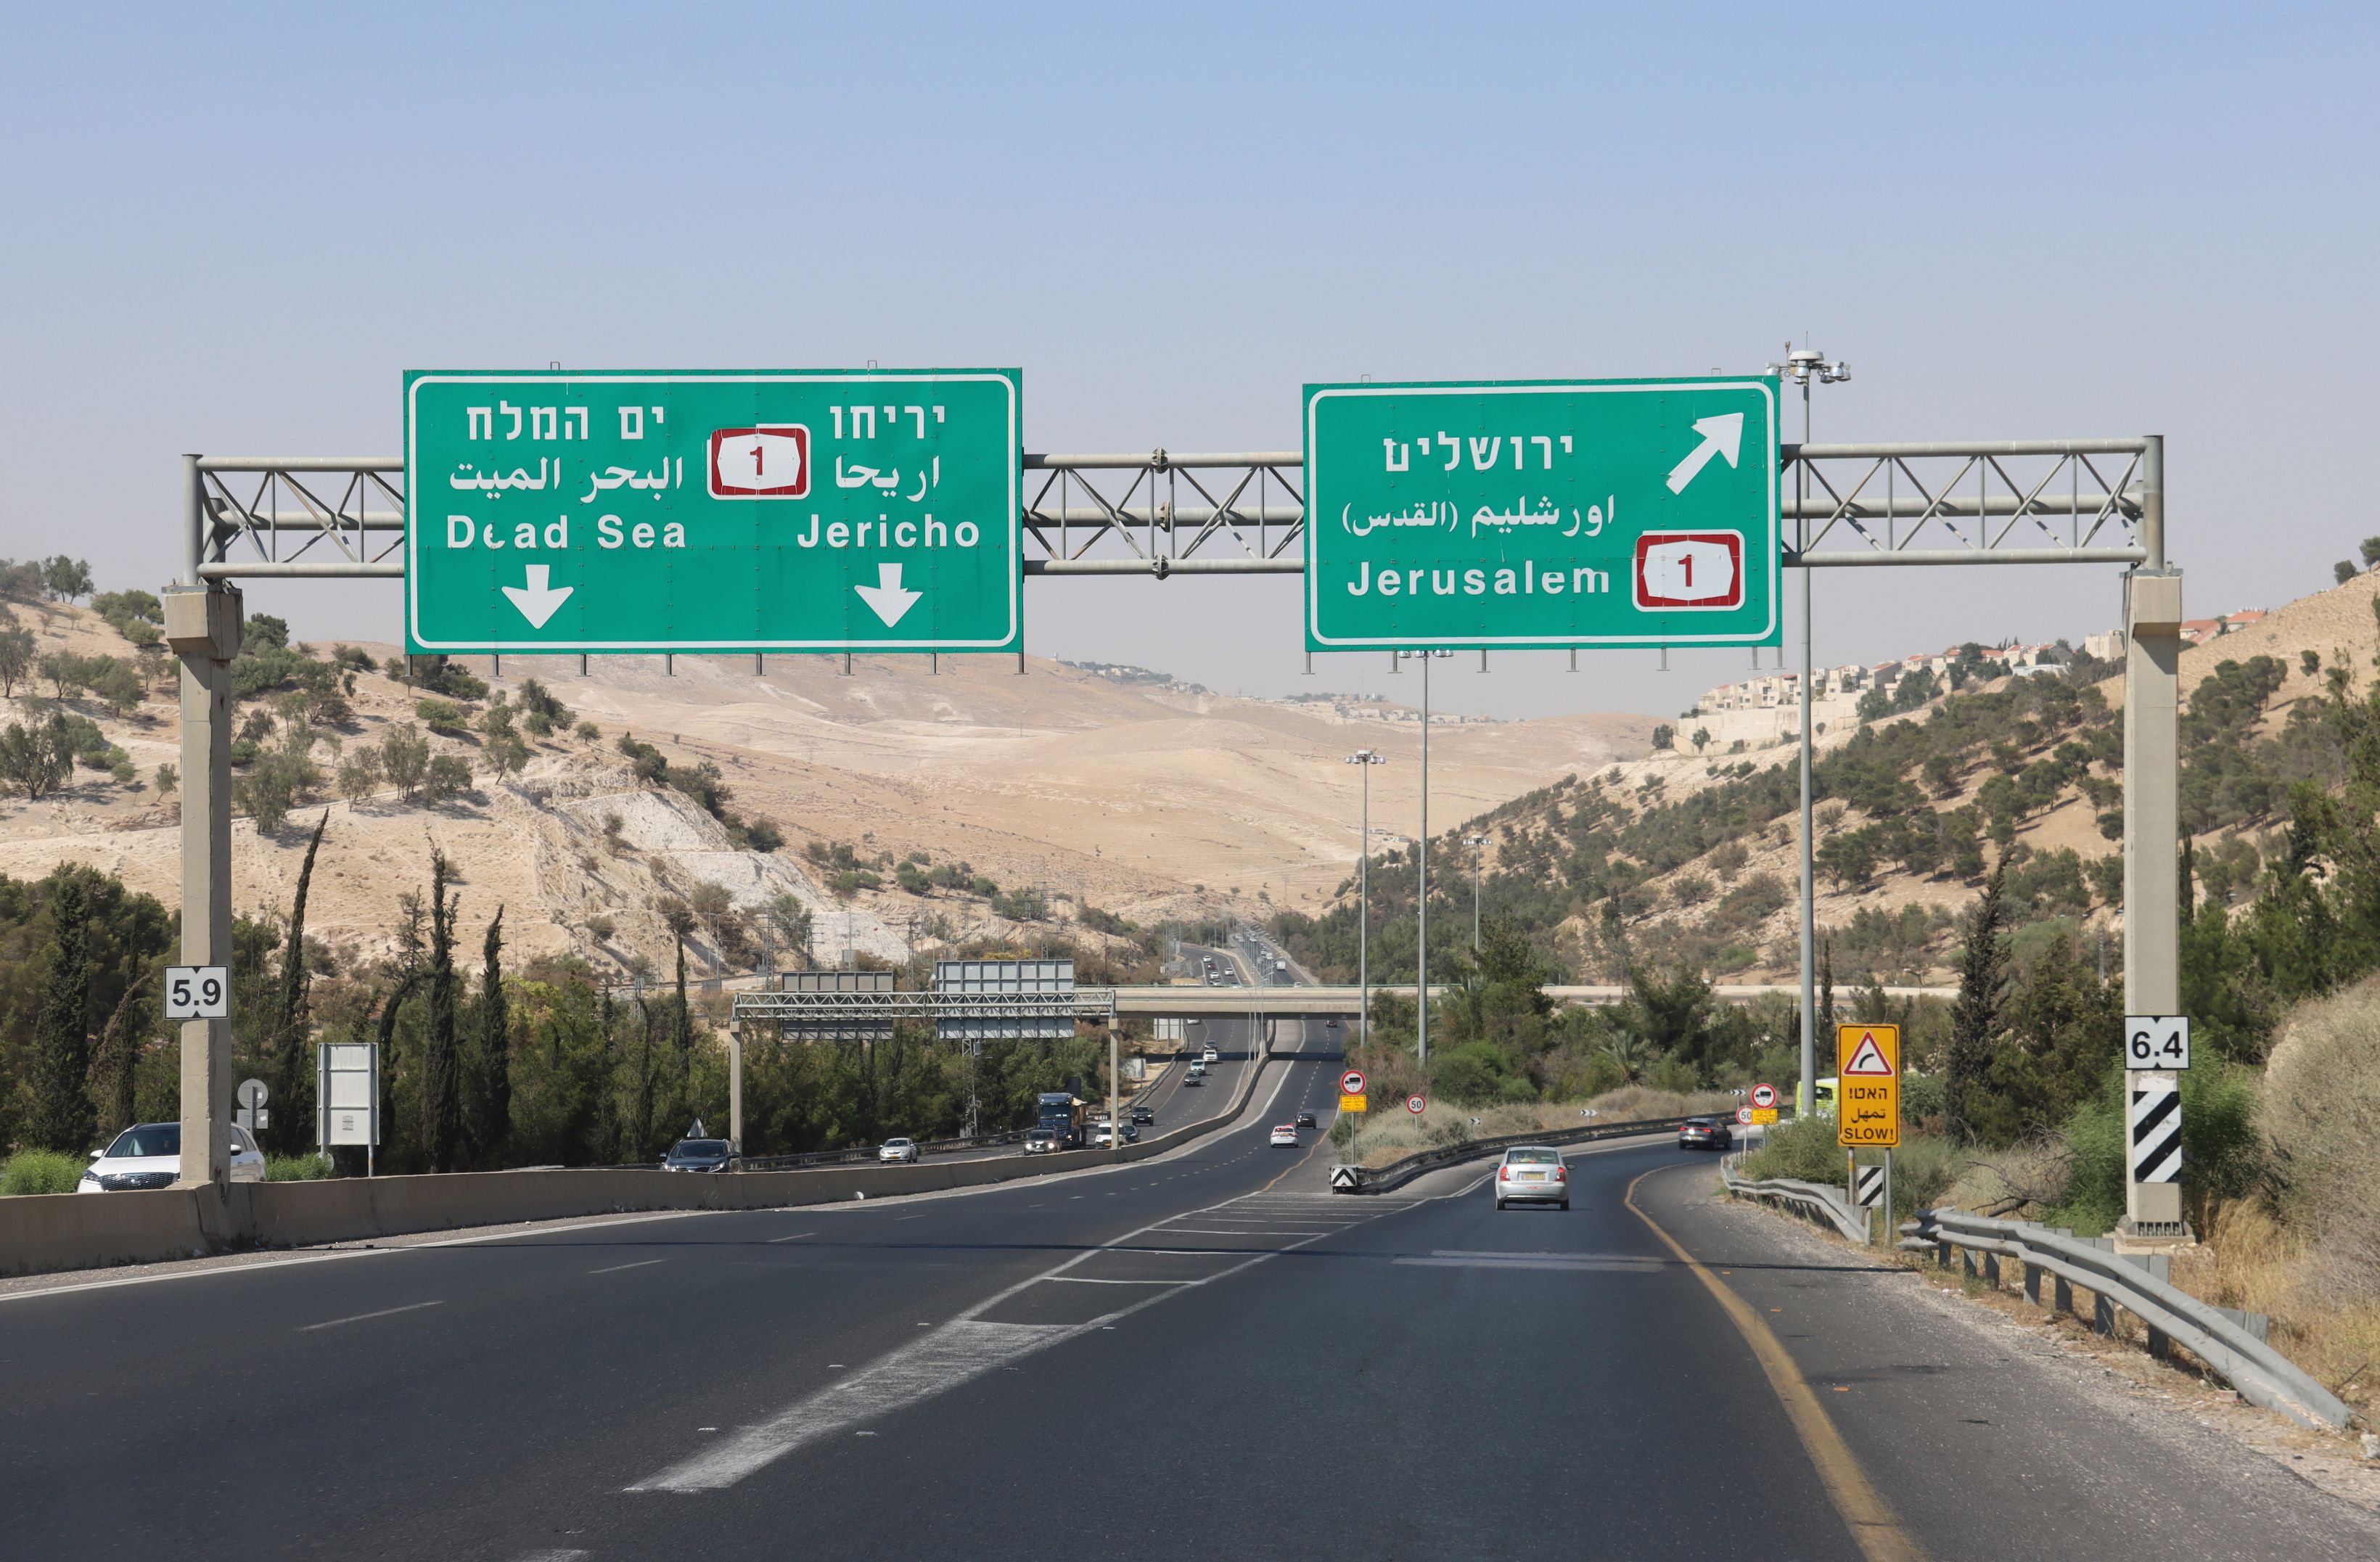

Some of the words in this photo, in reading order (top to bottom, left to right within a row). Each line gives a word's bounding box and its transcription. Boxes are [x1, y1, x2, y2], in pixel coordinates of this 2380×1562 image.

[467, 400, 588, 440] המלח
[617, 406, 664, 440] ים
[829, 406, 945, 439] יריחו
[749, 445, 763, 476] 1
[1383, 431, 1573, 472] ירושלים
[449, 456, 560, 499] الميت
[580, 456, 683, 503] البحر
[835, 456, 940, 502] اريحا
[447, 514, 568, 549] Dead
[597, 514, 686, 549] Sea
[797, 514, 980, 548] Jericho
[1472, 494, 1614, 539] اورشليم
[1347, 560, 1609, 596] Jerusalem
[1678, 554, 1692, 587] 1
[172, 978, 221, 1007] 5.9
[2131, 1031, 2183, 1059] 6.4
[1411, 1100, 1422, 1109] 50
[1849, 1088, 1887, 1100] האט!
[1741, 1111, 1752, 1120] 50
[1850, 1107, 1886, 1124] تمهل
[1844, 1127, 1894, 1140] SLOW!
